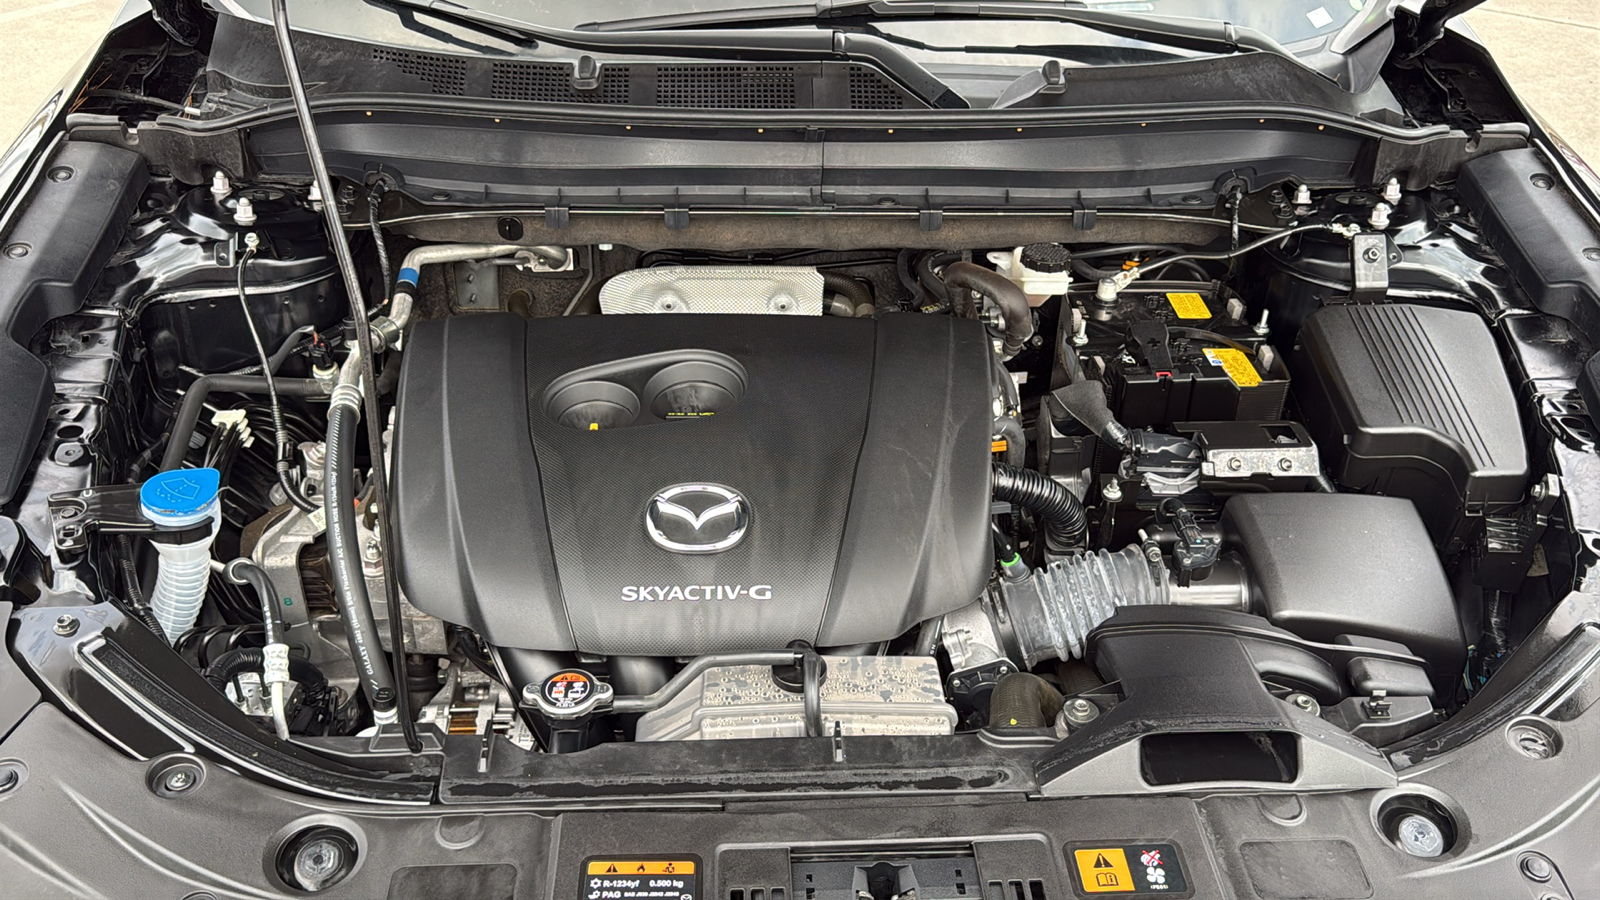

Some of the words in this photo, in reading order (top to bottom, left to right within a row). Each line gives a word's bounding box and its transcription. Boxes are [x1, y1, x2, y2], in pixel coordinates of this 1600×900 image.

[334, 522, 342, 548] SUCTION
[621, 585, 772, 601] SKYACTIV-G
[359, 645, 374, 675] GALAXY
[602, 880, 640, 888] R-1234yf
[649, 879, 671, 887] 0.500
[673, 879, 684, 888] kg
